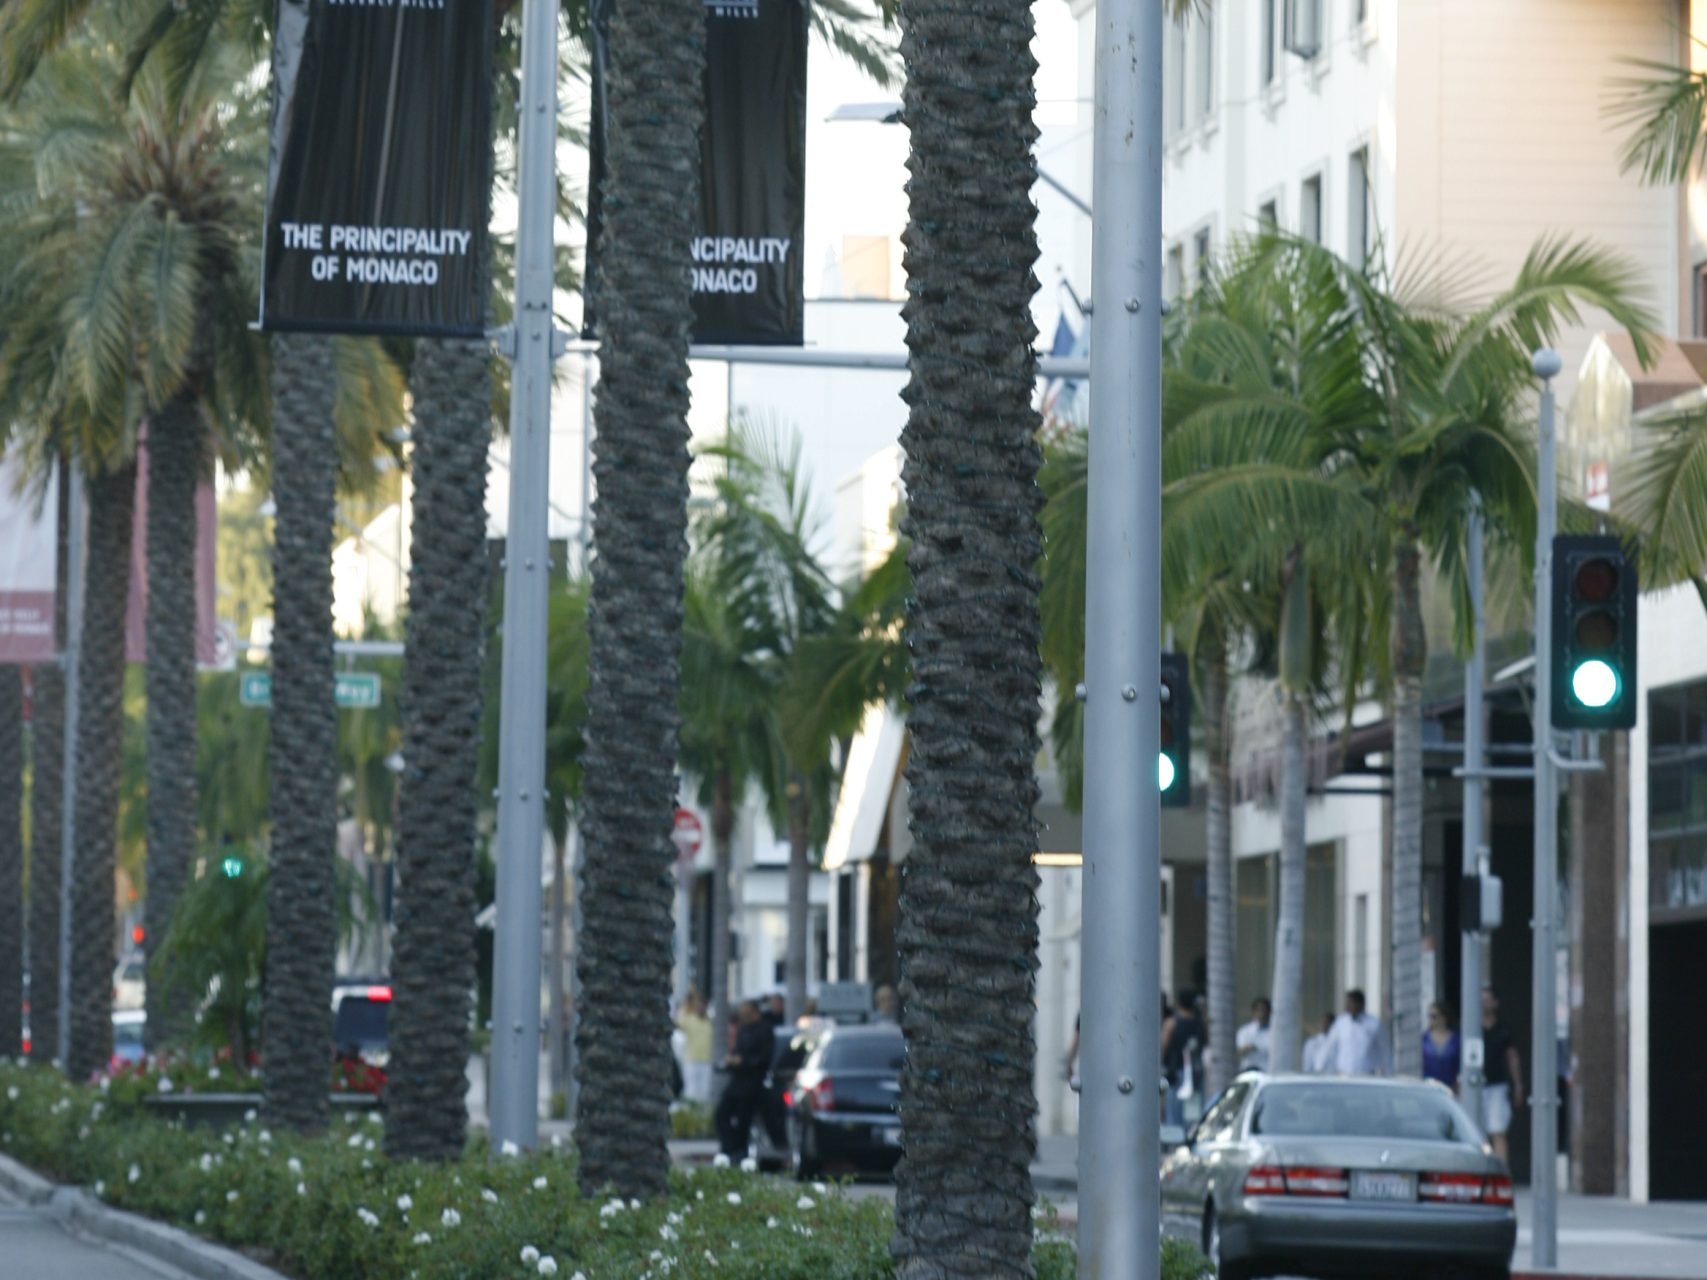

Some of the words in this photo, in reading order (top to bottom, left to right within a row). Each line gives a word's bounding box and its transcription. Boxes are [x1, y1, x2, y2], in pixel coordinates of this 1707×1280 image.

[281, 222, 323, 250] THE
[330, 225, 471, 255] PRINCIPALITY
[689, 236, 791, 263] NCIPALITY
[311, 255, 340, 281] OF
[346, 257, 438, 286] MONACO
[691, 267, 758, 293] NACO
